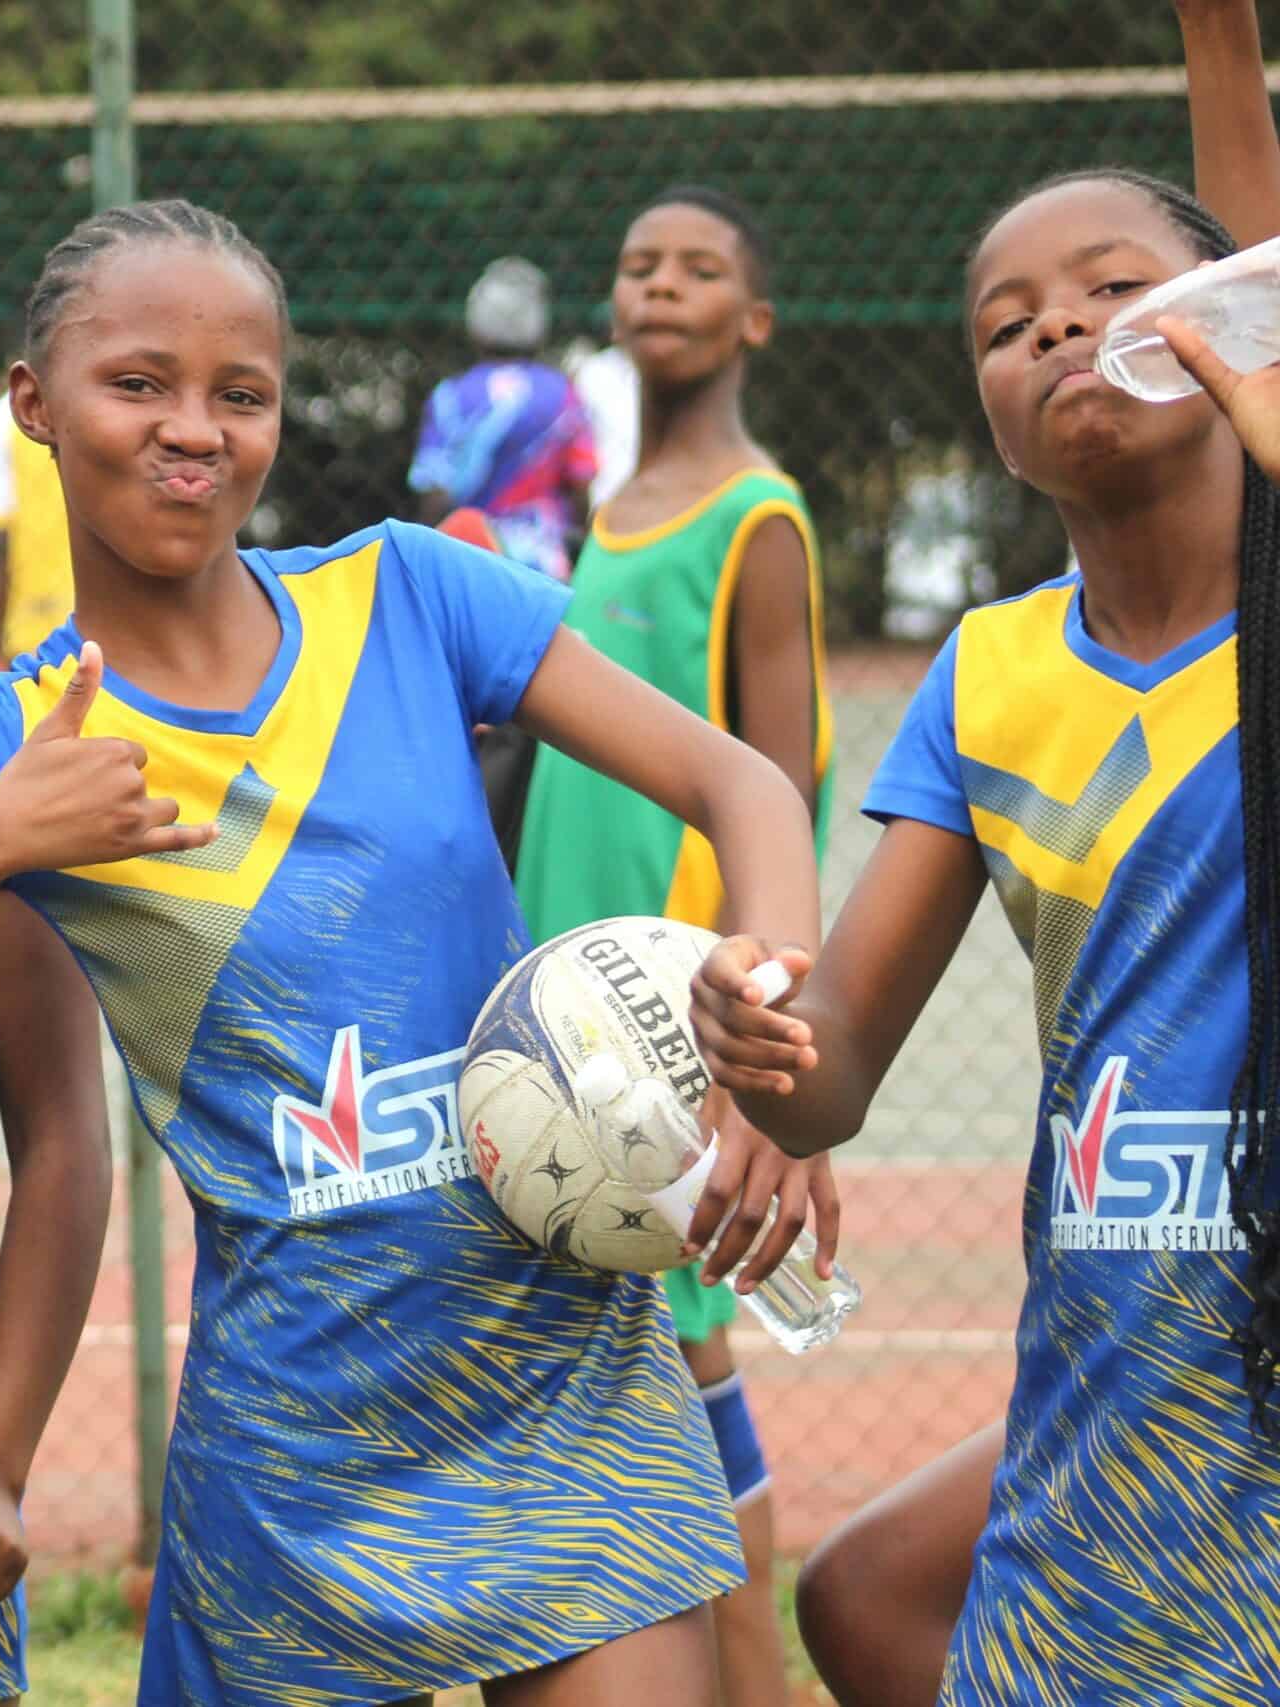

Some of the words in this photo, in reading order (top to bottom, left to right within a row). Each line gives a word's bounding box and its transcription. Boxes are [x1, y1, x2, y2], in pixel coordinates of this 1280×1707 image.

[580, 938, 711, 1103] GILBER
[604, 993, 658, 1073] SPECTRA
[290, 1166, 428, 1215] VERIFICATION
[1162, 1225, 1240, 1251] SERVIC
